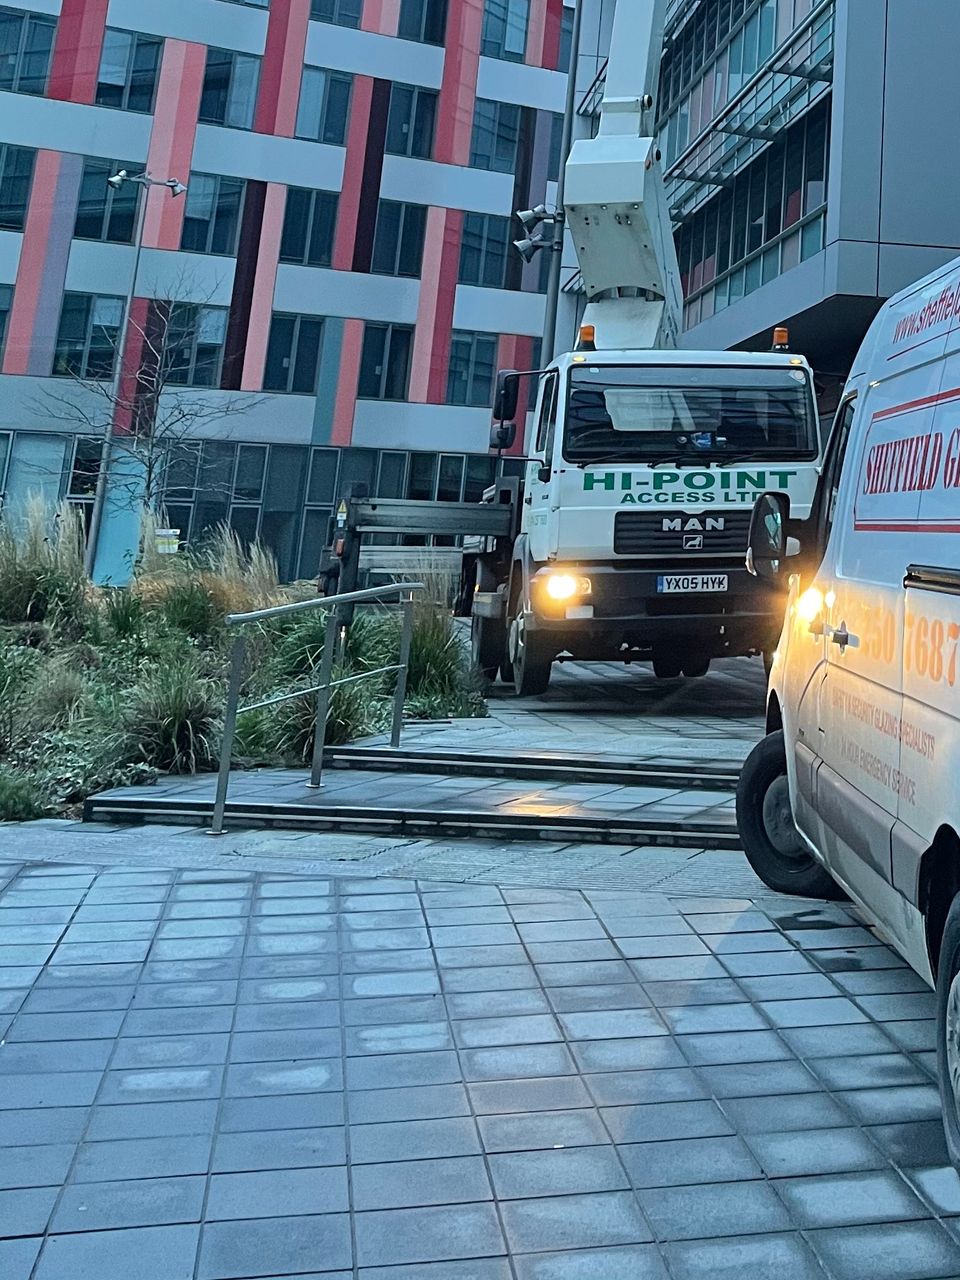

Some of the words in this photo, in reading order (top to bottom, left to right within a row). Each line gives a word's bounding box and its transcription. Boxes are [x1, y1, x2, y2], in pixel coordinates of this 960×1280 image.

[863, 432, 943, 495] SHEFFIELD
[583, 471, 797, 490] HI-POINT
[620, 491, 715, 504] ACCESS
[662, 518, 725, 531] MAN
[665, 577, 698, 590] YX05
[701, 576, 726, 589] HYK
[904, 611, 960, 687] 7687
[874, 707, 898, 739] GLAZING
